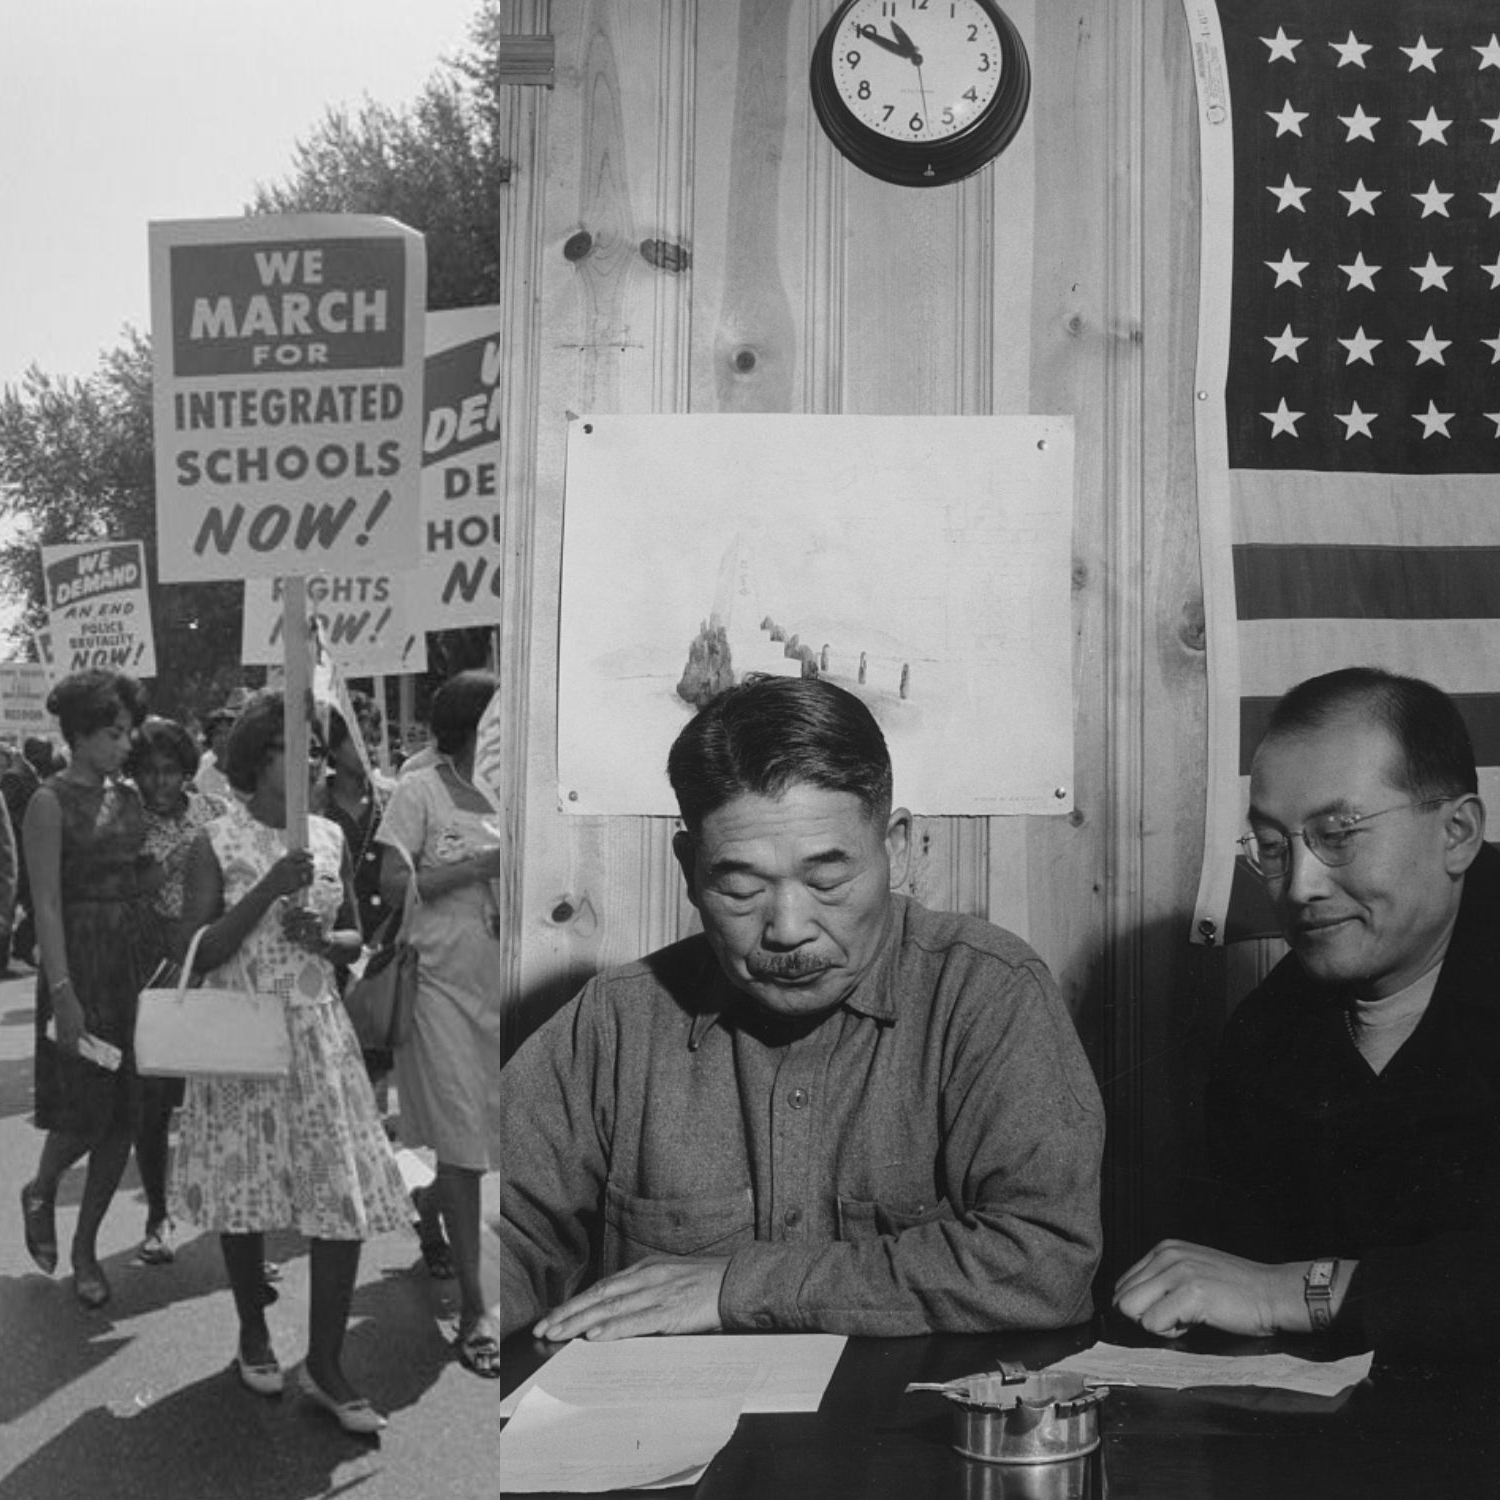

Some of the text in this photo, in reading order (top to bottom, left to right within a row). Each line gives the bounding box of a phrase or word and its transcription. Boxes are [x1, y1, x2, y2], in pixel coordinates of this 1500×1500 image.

[966, 23, 978, 42] 2
[846, 50, 861, 70] 9
[977, 52, 990, 72] 3
[857, 80, 871, 100] 8
[961, 85, 978, 103] 4
[882, 105, 895, 122] 7
[909, 112, 924, 131] 6
[941, 107, 955, 125] 5
[254, 249, 324, 286] WE
[190, 290, 388, 339] MARCH
[252, 343, 329, 367] FOR
[174, 382, 404, 431] INTEGRATED
[176, 440, 401, 486] SCHOOLS
[193, 489, 393, 556] NOW!
[78, 550, 111, 575] WE
[56, 564, 138, 604] DEMAND
[272, 576, 389, 602] RGHTS
[64, 601, 134, 619] AN END
[71, 642, 145, 671] NOW!
